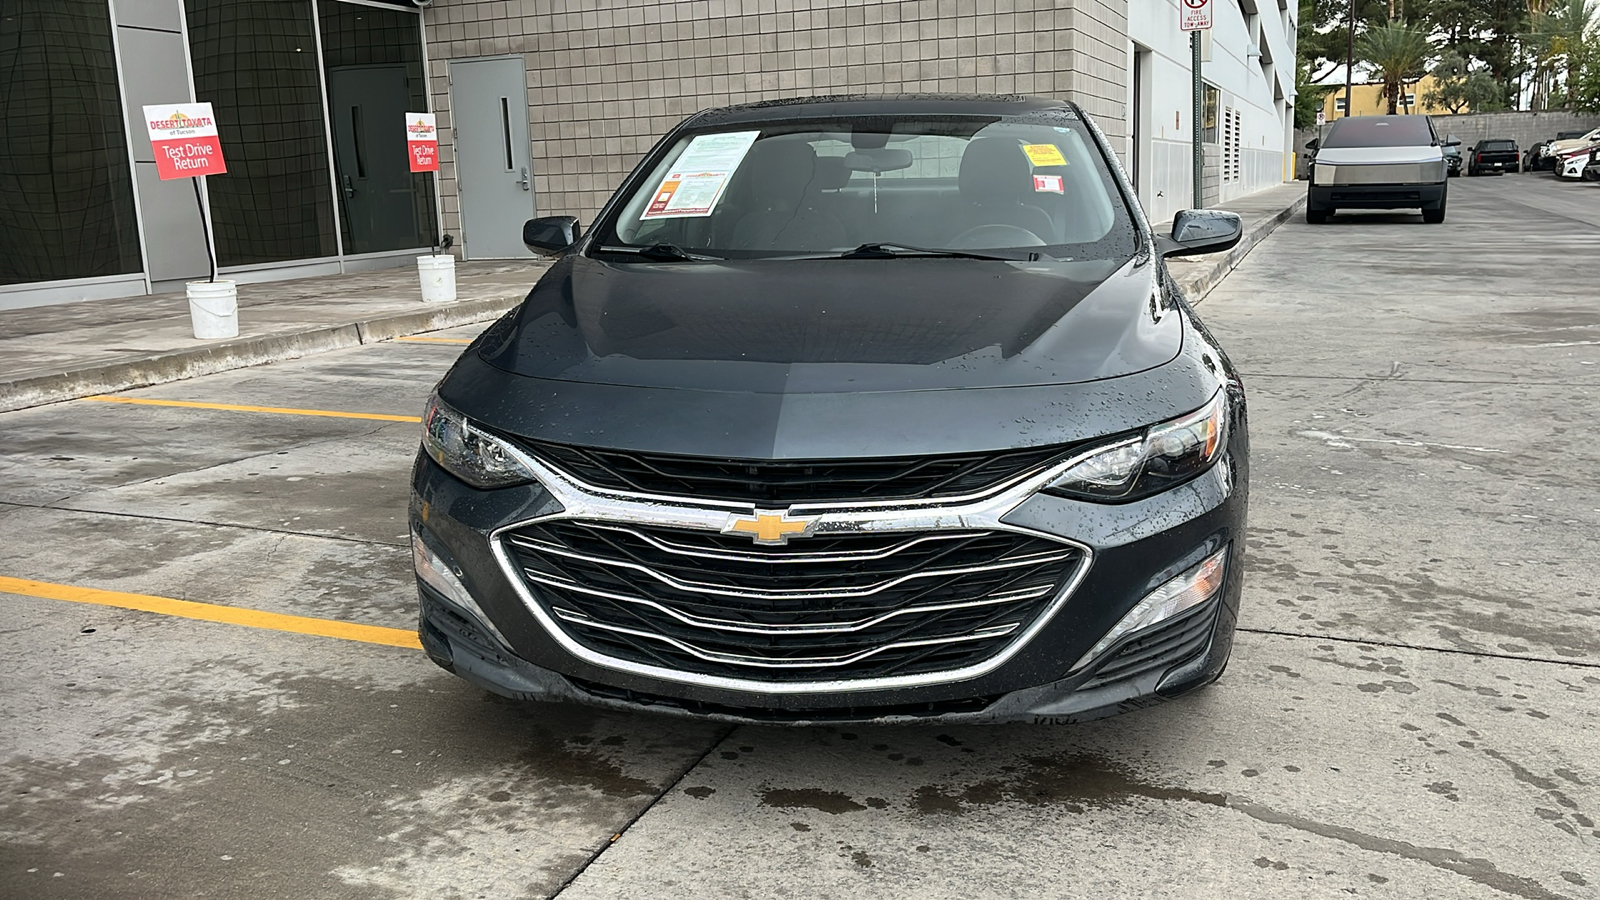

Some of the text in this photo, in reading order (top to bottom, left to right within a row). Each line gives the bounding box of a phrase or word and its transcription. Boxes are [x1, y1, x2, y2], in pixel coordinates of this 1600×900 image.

[150, 118, 212, 130] DESERT TOYOTA
[162, 143, 213, 158] Test Drive
[412, 145, 422, 156] Test
[174, 157, 208, 170] Return
